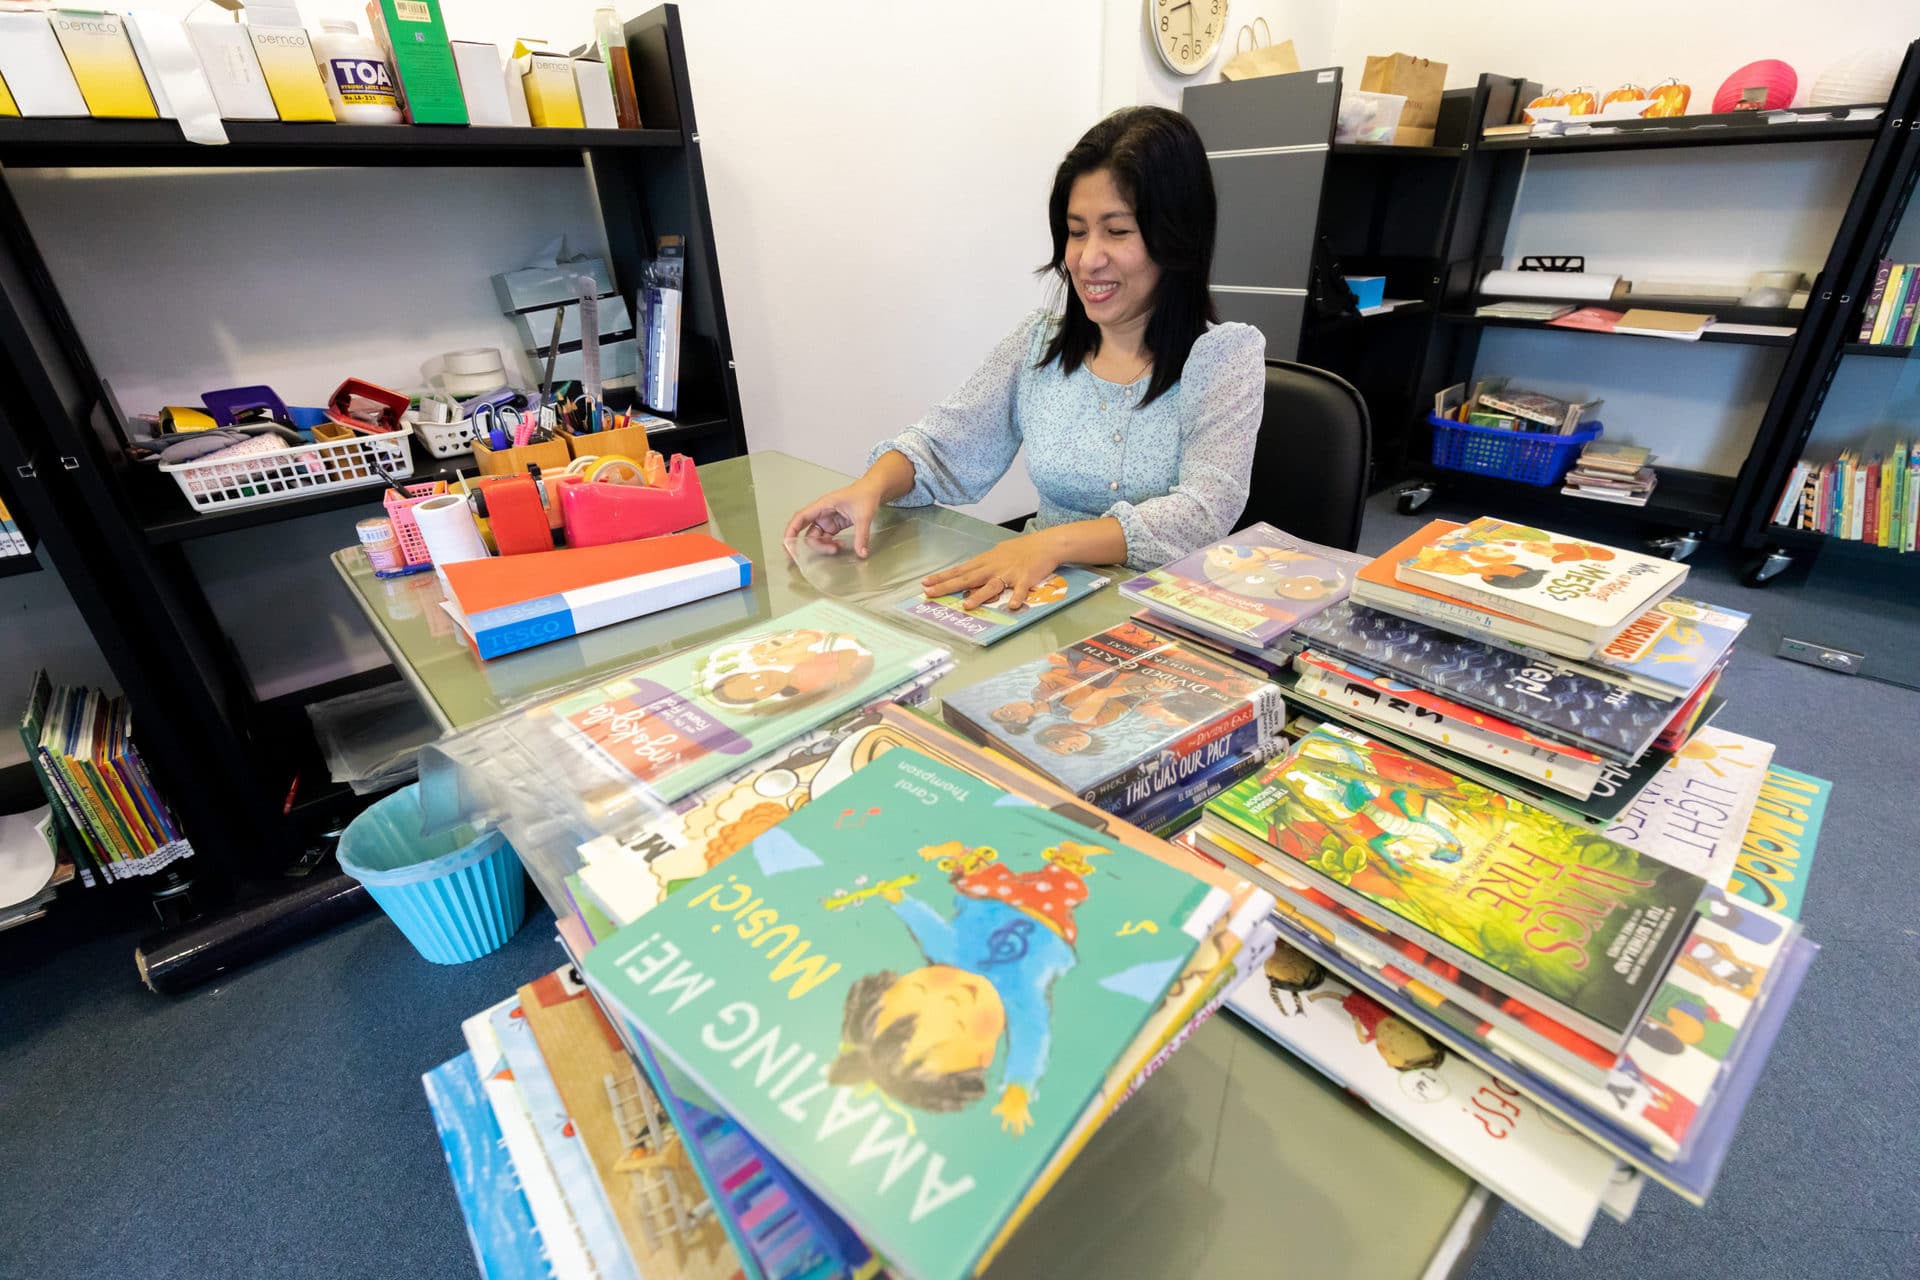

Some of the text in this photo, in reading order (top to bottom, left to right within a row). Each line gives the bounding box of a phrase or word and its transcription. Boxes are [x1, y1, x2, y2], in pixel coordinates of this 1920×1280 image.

[1161, 16, 1169, 32] 8
[1205, 23, 1212, 35] 4
[1171, 36, 1178, 52] 7
[1181, 44, 1189, 60] 6
[1194, 40, 1201, 55] 5
[336, 61, 392, 86] TOA
[1872, 268, 1889, 301] CATS
[1540, 562, 1610, 601] MESS?
[1627, 562, 1664, 580] Who
[488, 620, 560, 649] TESCO
[1106, 640, 1138, 655] HICKS
[1604, 611, 1668, 659] DINOSAURS
[1141, 667, 1211, 694] DIVIDED
[1196, 721, 1230, 746] DIVIDED
[898, 760, 969, 803] Thompson
[1125, 776, 1151, 806] THIS
[1154, 760, 1179, 792] WAS
[1179, 752, 1206, 777] OUR
[1206, 733, 1232, 766] PACT
[896, 777, 939, 805] Carol
[1099, 775, 1127, 794] HICKS
[1185, 780, 1209, 799] SALVADOR
[1663, 778, 1738, 858] LIGHT
[1466, 841, 1566, 924] FIRE
[1523, 863, 1656, 970] WINGS
[613, 932, 715, 1015] ME!
[700, 1001, 976, 1223] AMAZING
